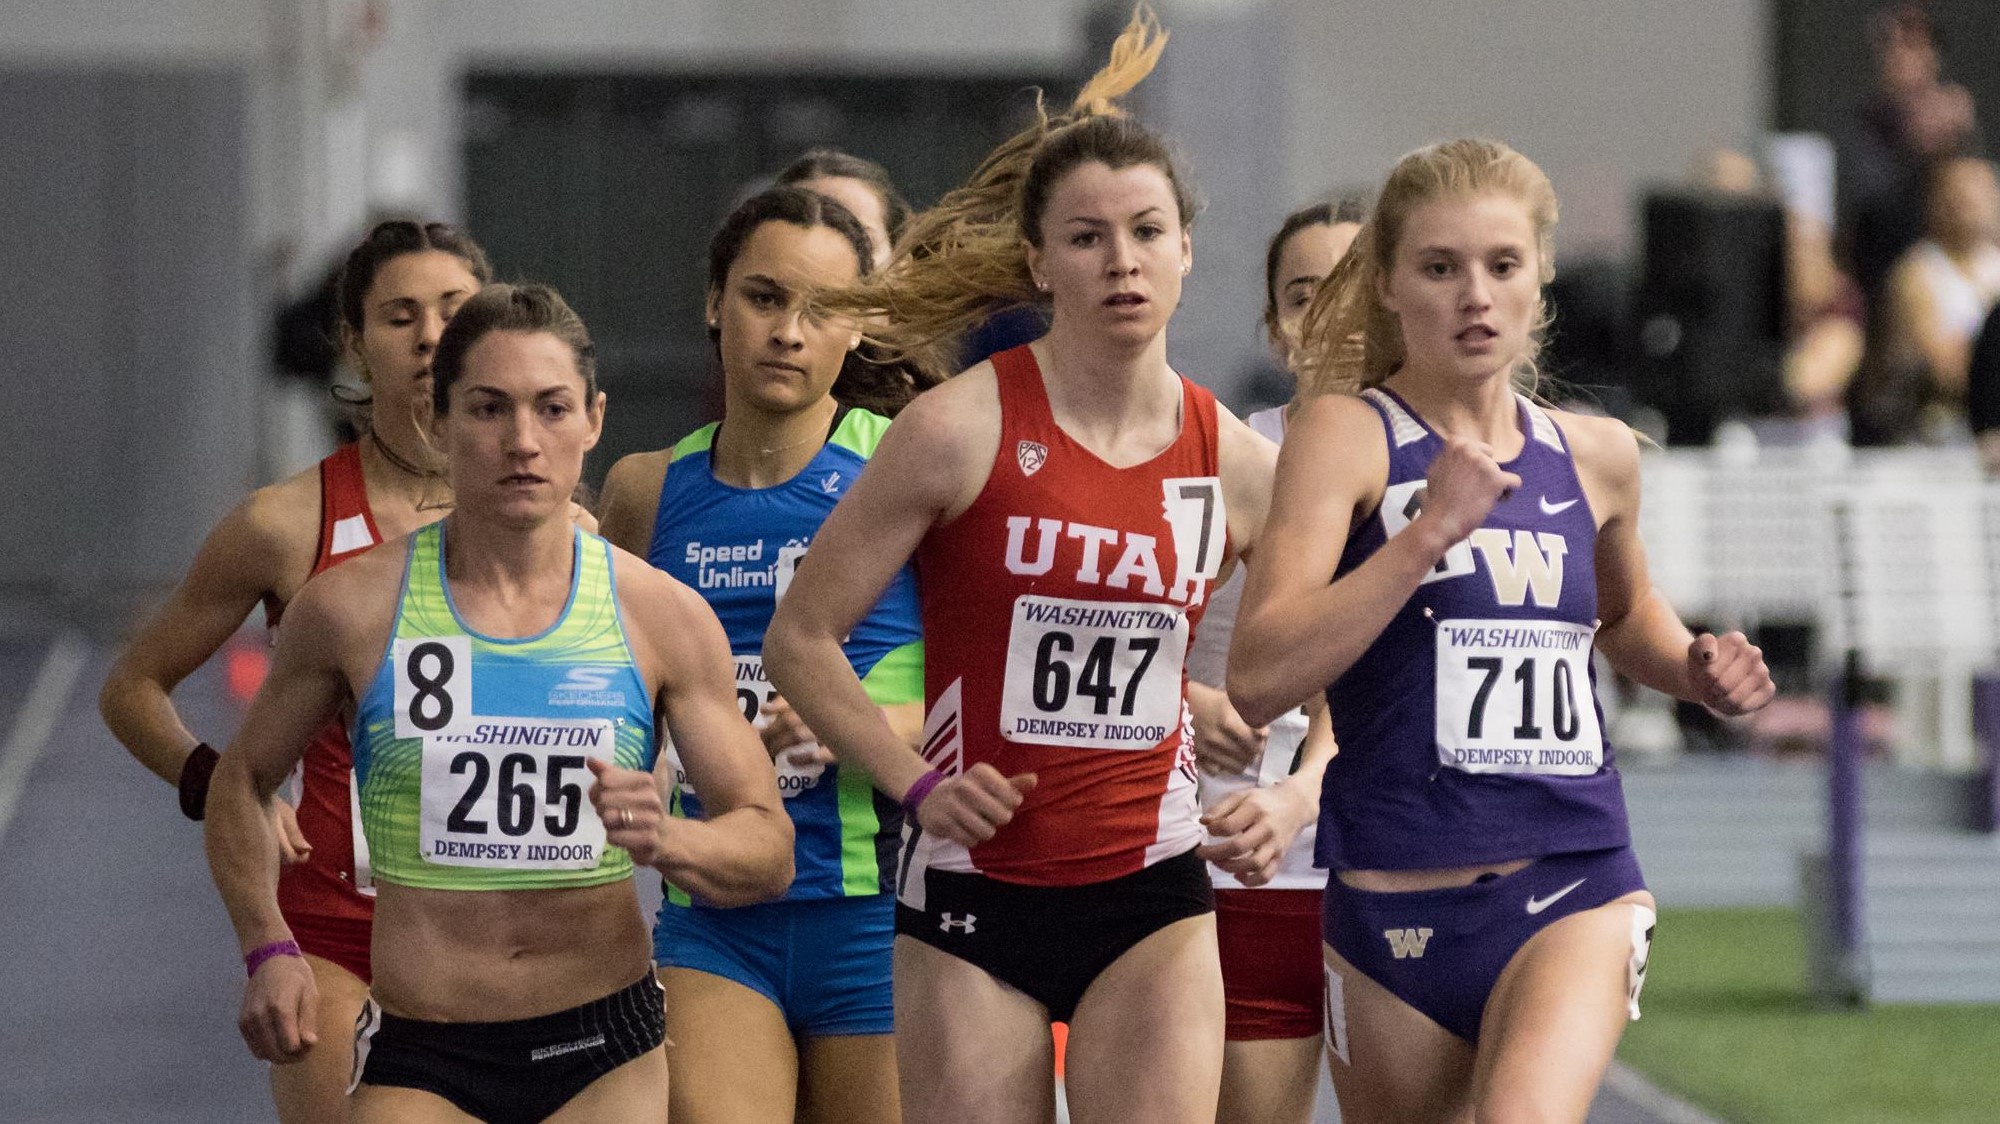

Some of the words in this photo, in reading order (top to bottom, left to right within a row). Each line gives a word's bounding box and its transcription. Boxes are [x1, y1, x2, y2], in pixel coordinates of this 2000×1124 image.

[1022, 457, 1038, 470] 12
[1179, 485, 1214, 573] 7
[685, 539, 763, 569] Speed
[1468, 528, 1569, 607] W
[698, 565, 778, 588] Unlimi
[1026, 602, 1178, 630] WASHINGTON
[1450, 628, 1584, 650] WASHINGTON
[407, 641, 455, 731] 8
[1033, 631, 1160, 716] 647
[1467, 656, 1580, 741] 710
[436, 725, 603, 746] SHINGTON
[1016, 718, 1100, 738] DEMPSEY
[1104, 724, 1165, 741] INDOOR
[1454, 749, 1533, 765] DEMPSEY
[1539, 750, 1594, 766] INDOOR
[447, 751, 586, 837] 265
[435, 840, 521, 860] DEMPSEY
[527, 844, 593, 860] INDOOR
[1384, 928, 1434, 959] W
